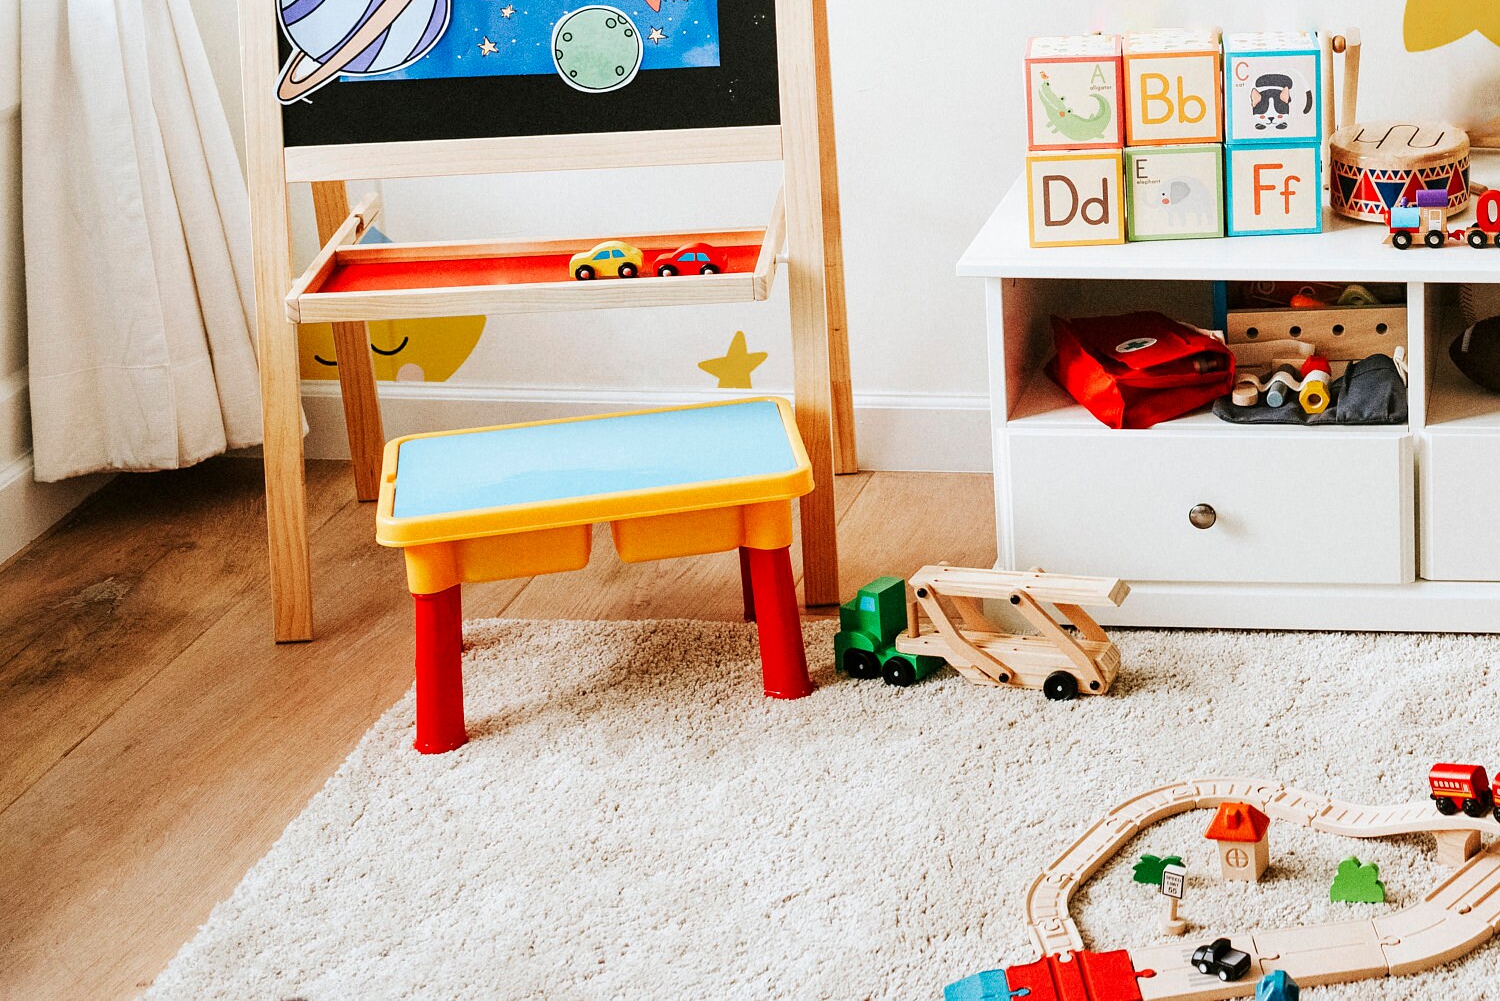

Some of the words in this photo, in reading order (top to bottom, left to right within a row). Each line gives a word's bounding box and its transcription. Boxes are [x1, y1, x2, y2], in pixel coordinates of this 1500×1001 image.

[1090, 63, 1106, 84] A
[1235, 61, 1249, 81] C
[1140, 73, 1207, 125] Bb
[1136, 159, 1149, 179] E
[1042, 174, 1108, 227] Dd
[1253, 163, 1301, 216] Ff
